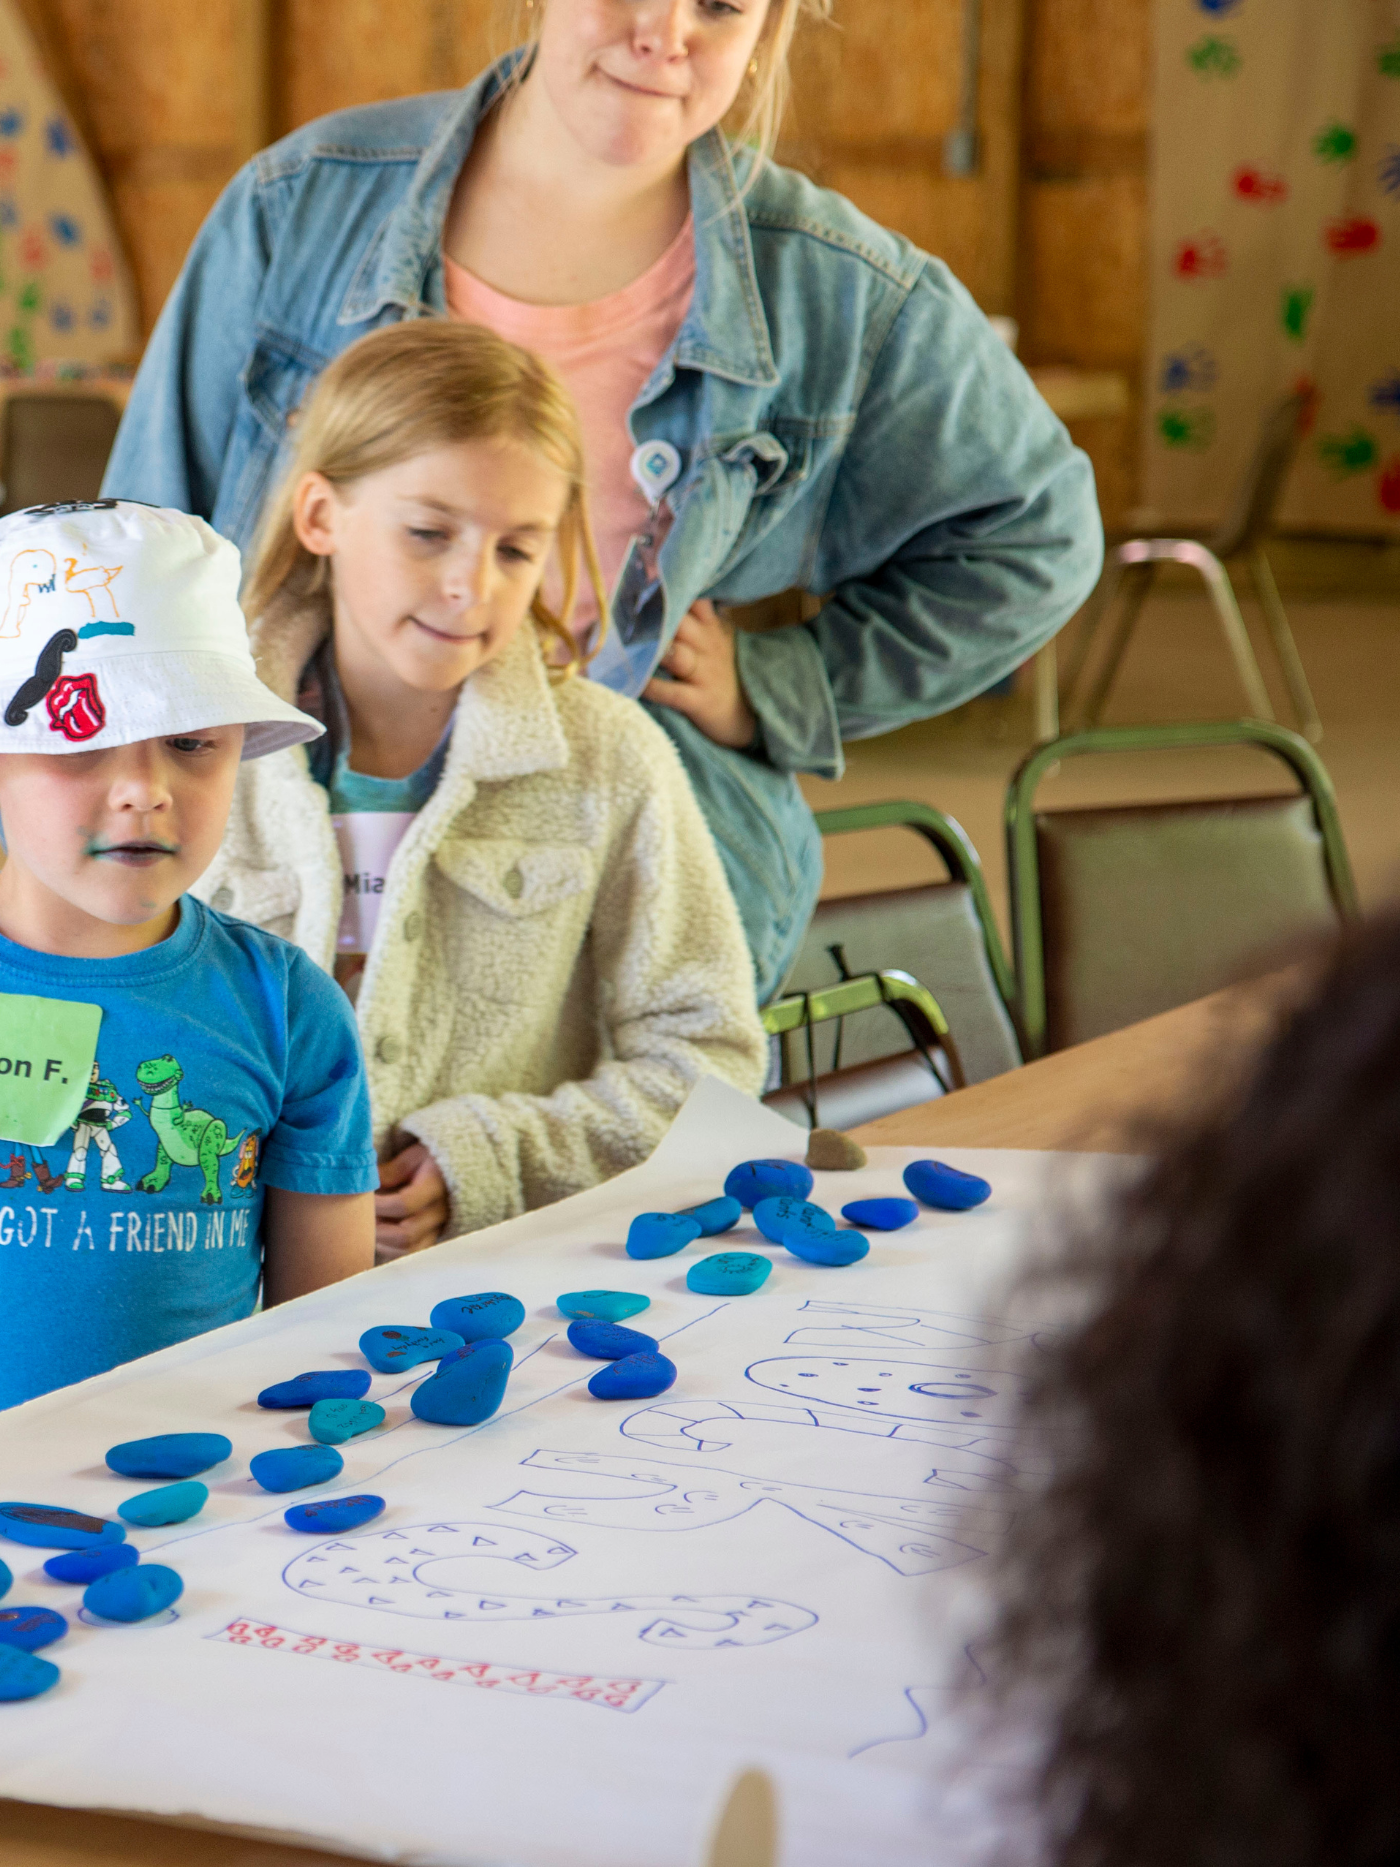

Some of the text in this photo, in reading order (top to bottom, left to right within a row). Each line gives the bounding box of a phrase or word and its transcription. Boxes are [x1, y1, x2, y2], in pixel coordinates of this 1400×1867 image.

[344, 872, 385, 894] Mia
[43, 1059, 68, 1084] F.
[72, 1211, 95, 1251] A
[110, 1211, 197, 1253] FRIEND
[205, 1211, 225, 1251] IN
[229, 1207, 252, 1248] ME
